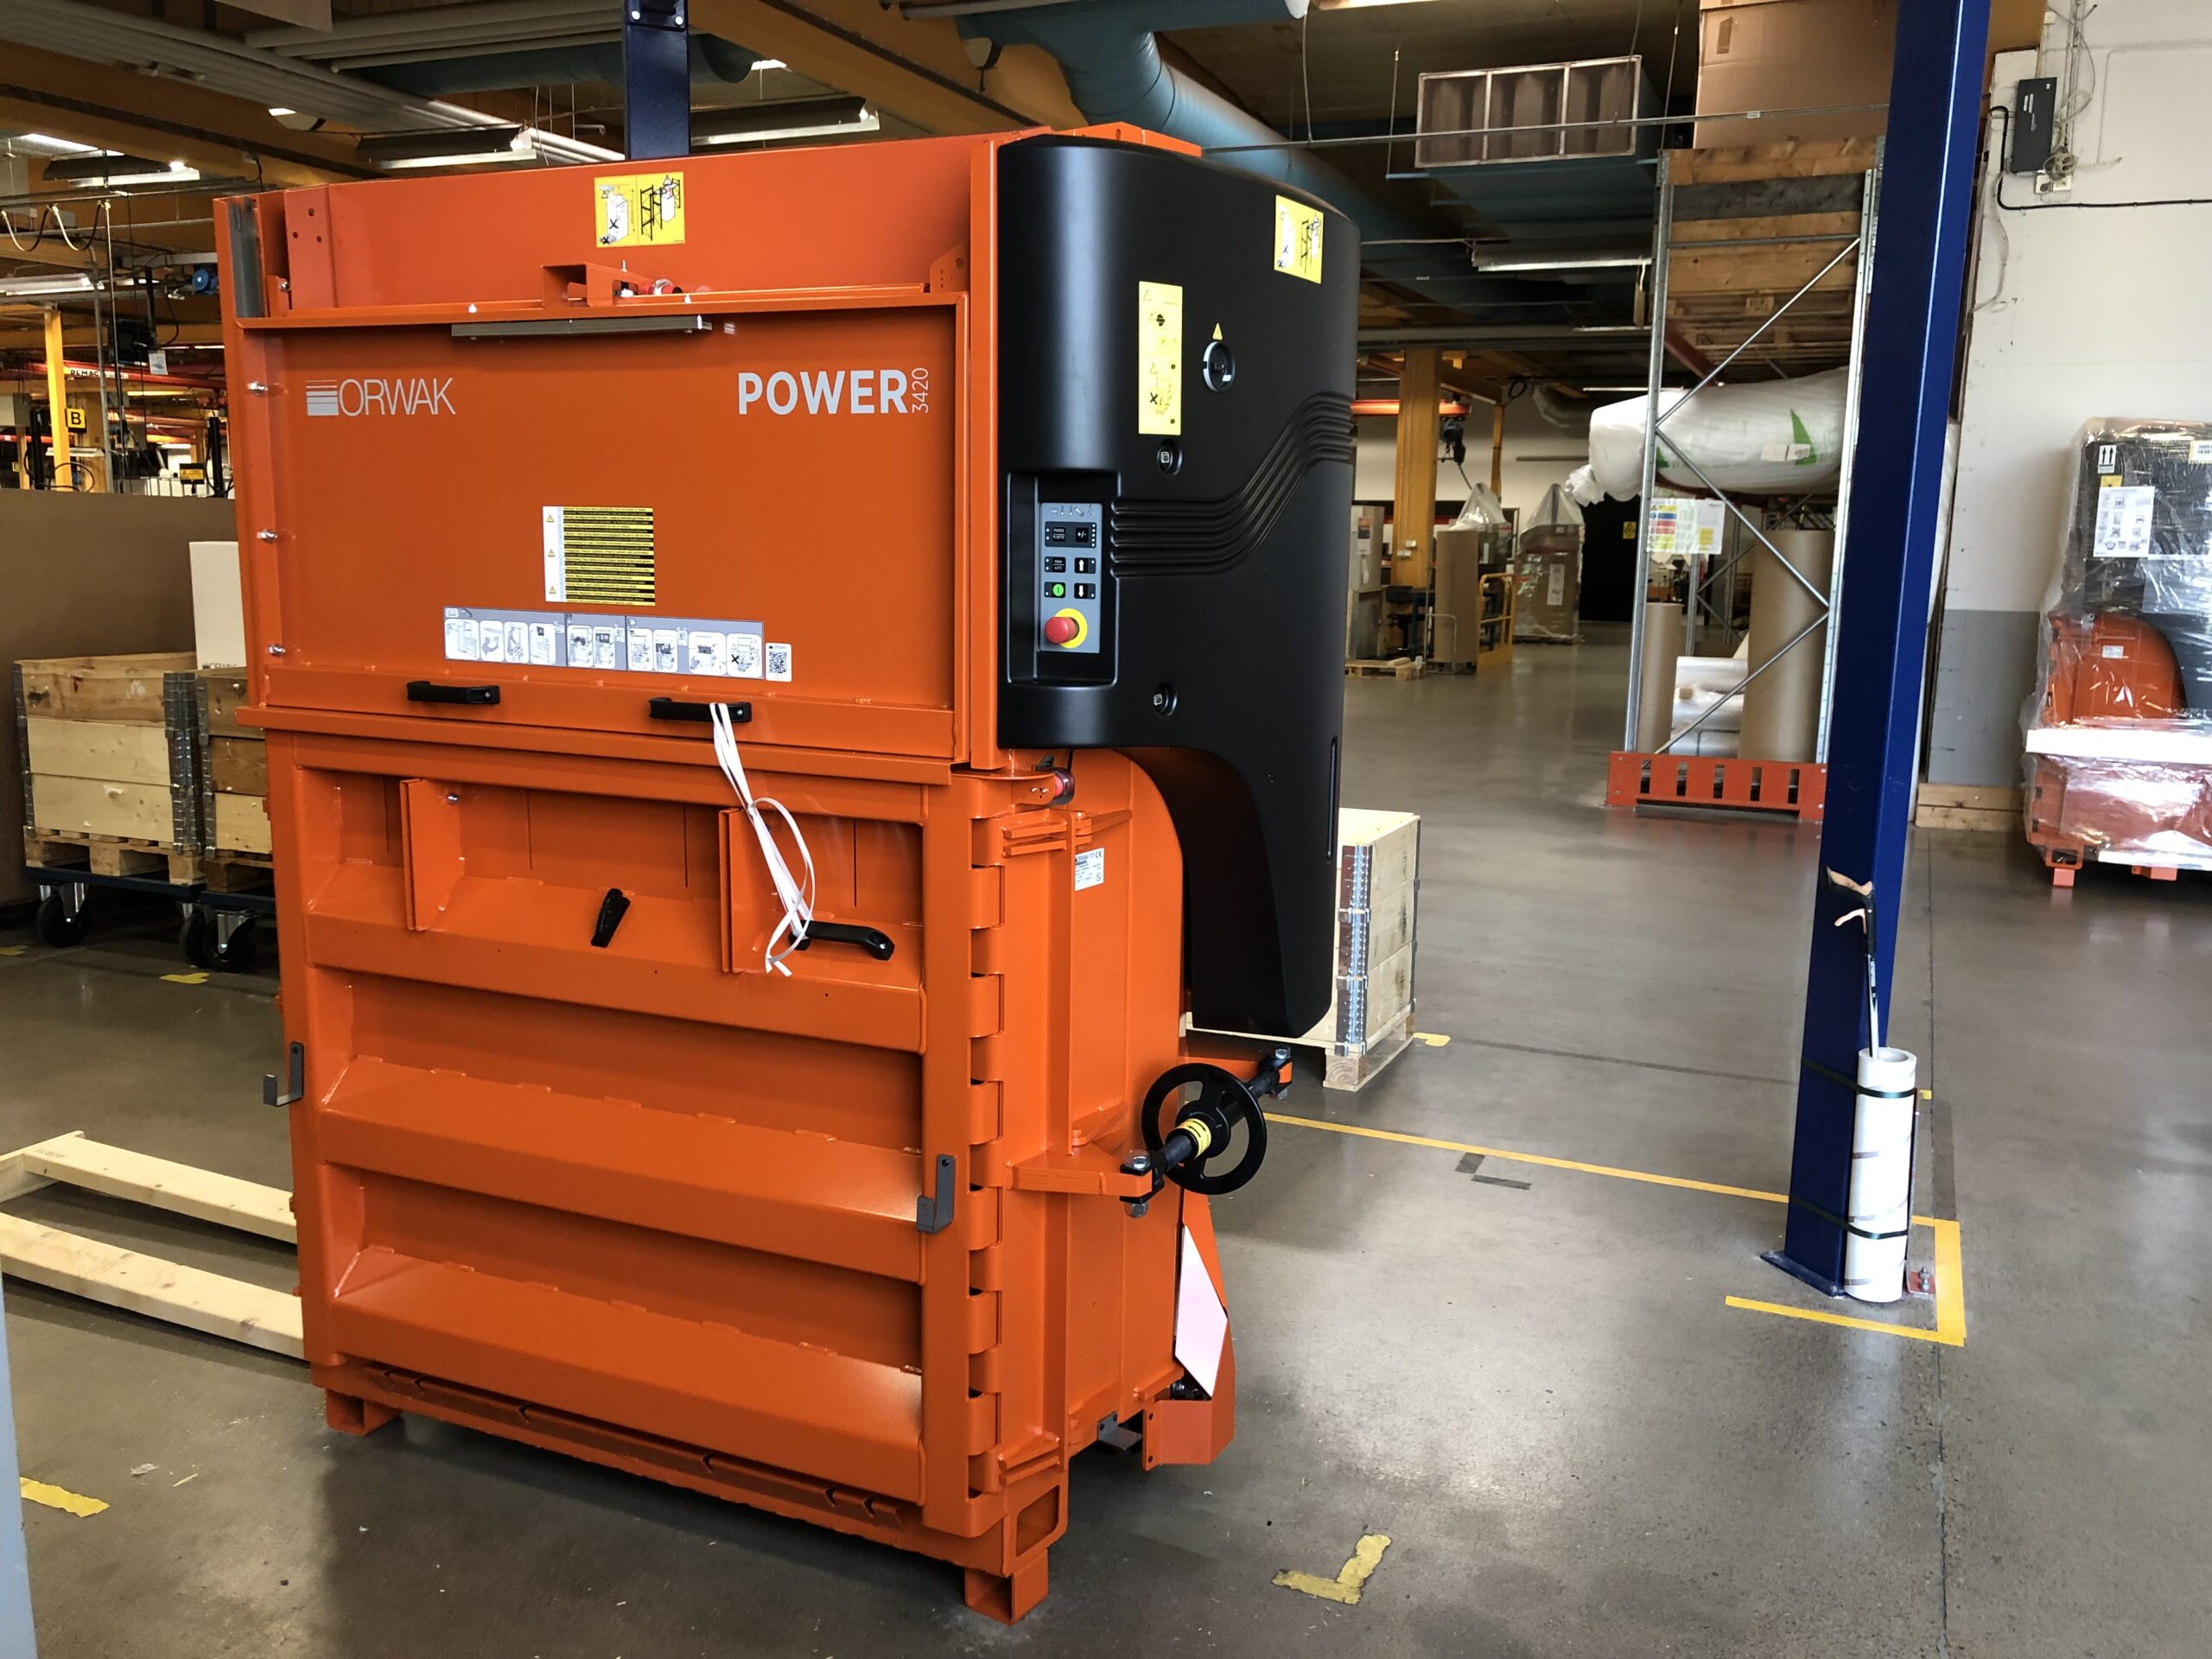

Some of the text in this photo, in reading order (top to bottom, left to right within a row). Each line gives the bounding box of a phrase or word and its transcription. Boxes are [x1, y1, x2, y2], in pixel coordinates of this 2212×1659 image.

[339, 378, 456, 416] ORWAK
[738, 369, 908, 415] POWER
[912, 367, 929, 414] 3420
[71, 411, 82, 425] B
